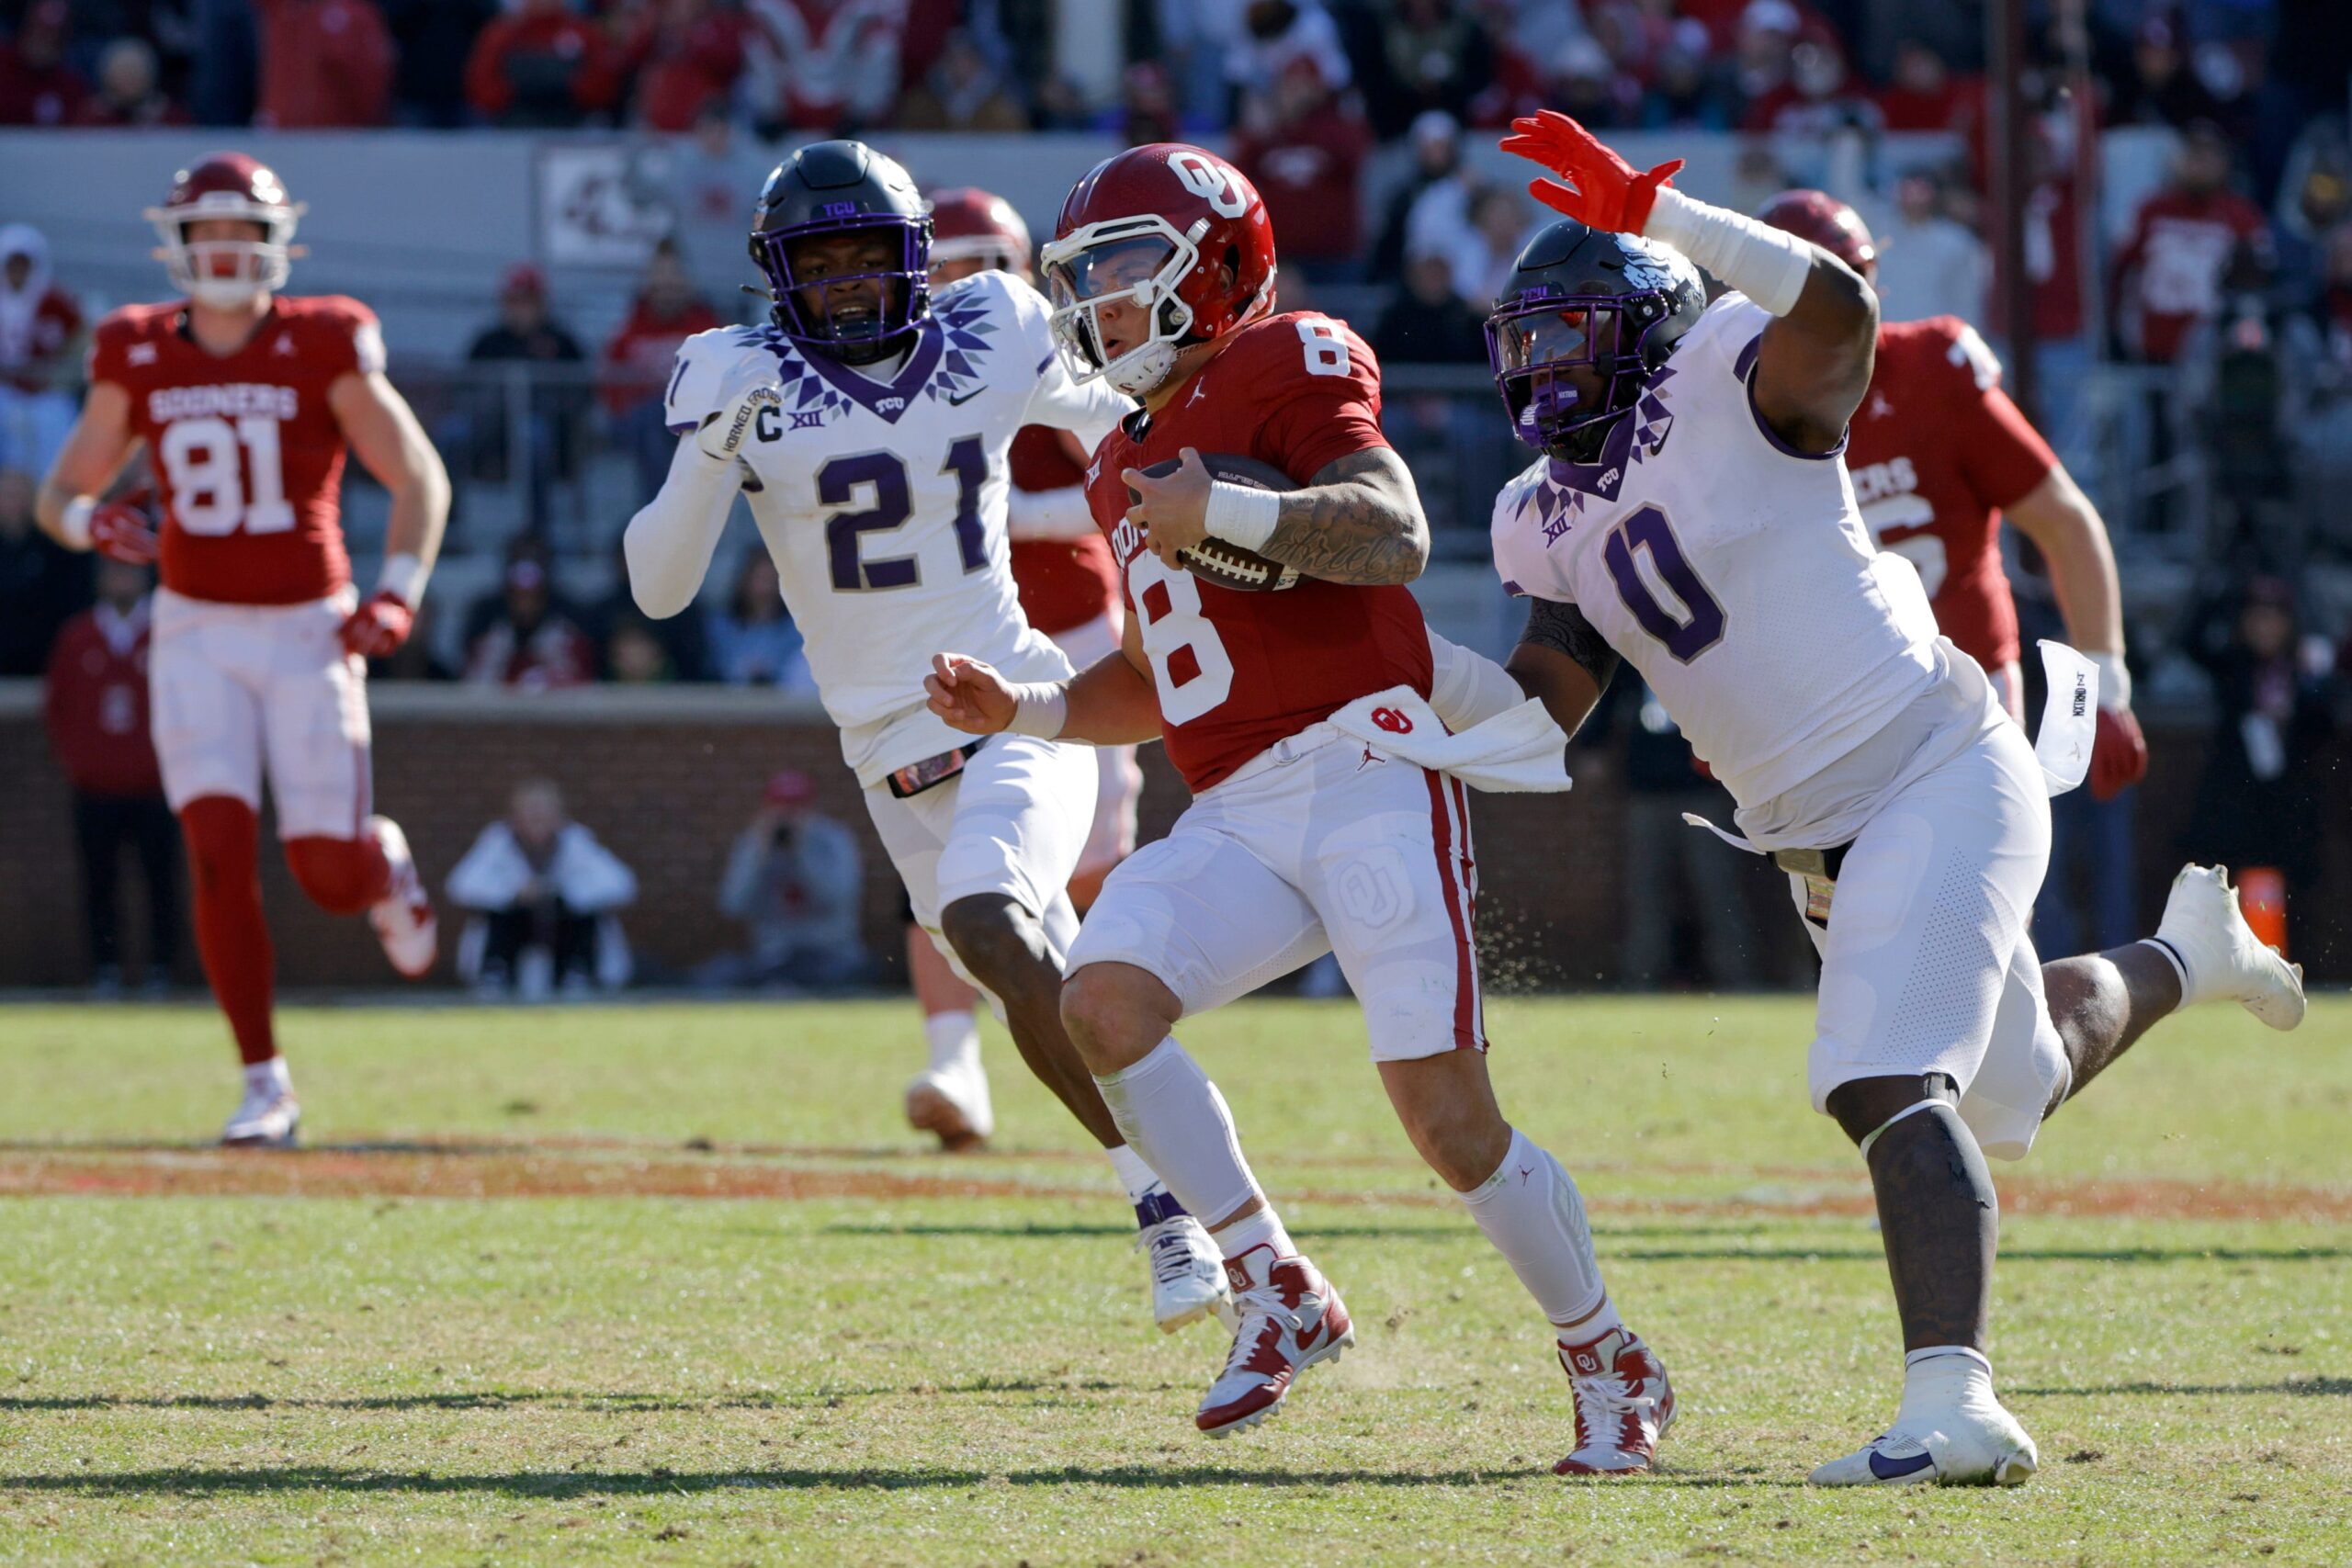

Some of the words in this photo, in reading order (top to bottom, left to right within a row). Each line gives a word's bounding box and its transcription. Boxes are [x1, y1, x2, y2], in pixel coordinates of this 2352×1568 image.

[1167, 152, 1248, 220] OU
[823, 201, 856, 216] TCU
[1519, 285, 1548, 300] TCU
[1295, 318, 1351, 377] 8
[149, 384, 297, 422] SOONERS
[786, 409, 826, 432] XII
[875, 396, 905, 413] TCU
[722, 405, 752, 453] HORNED
[756, 405, 783, 443] C
[162, 417, 295, 536] 81
[1596, 467, 1620, 493] TCU
[812, 432, 991, 593] 21
[1542, 512, 1572, 548] XII
[1600, 501, 1729, 667] 0
[1127, 547, 1235, 728] 8
[1371, 706, 1413, 735] OU
[1227, 1267, 1247, 1287] OU
[1577, 1353, 1598, 1371] OU
